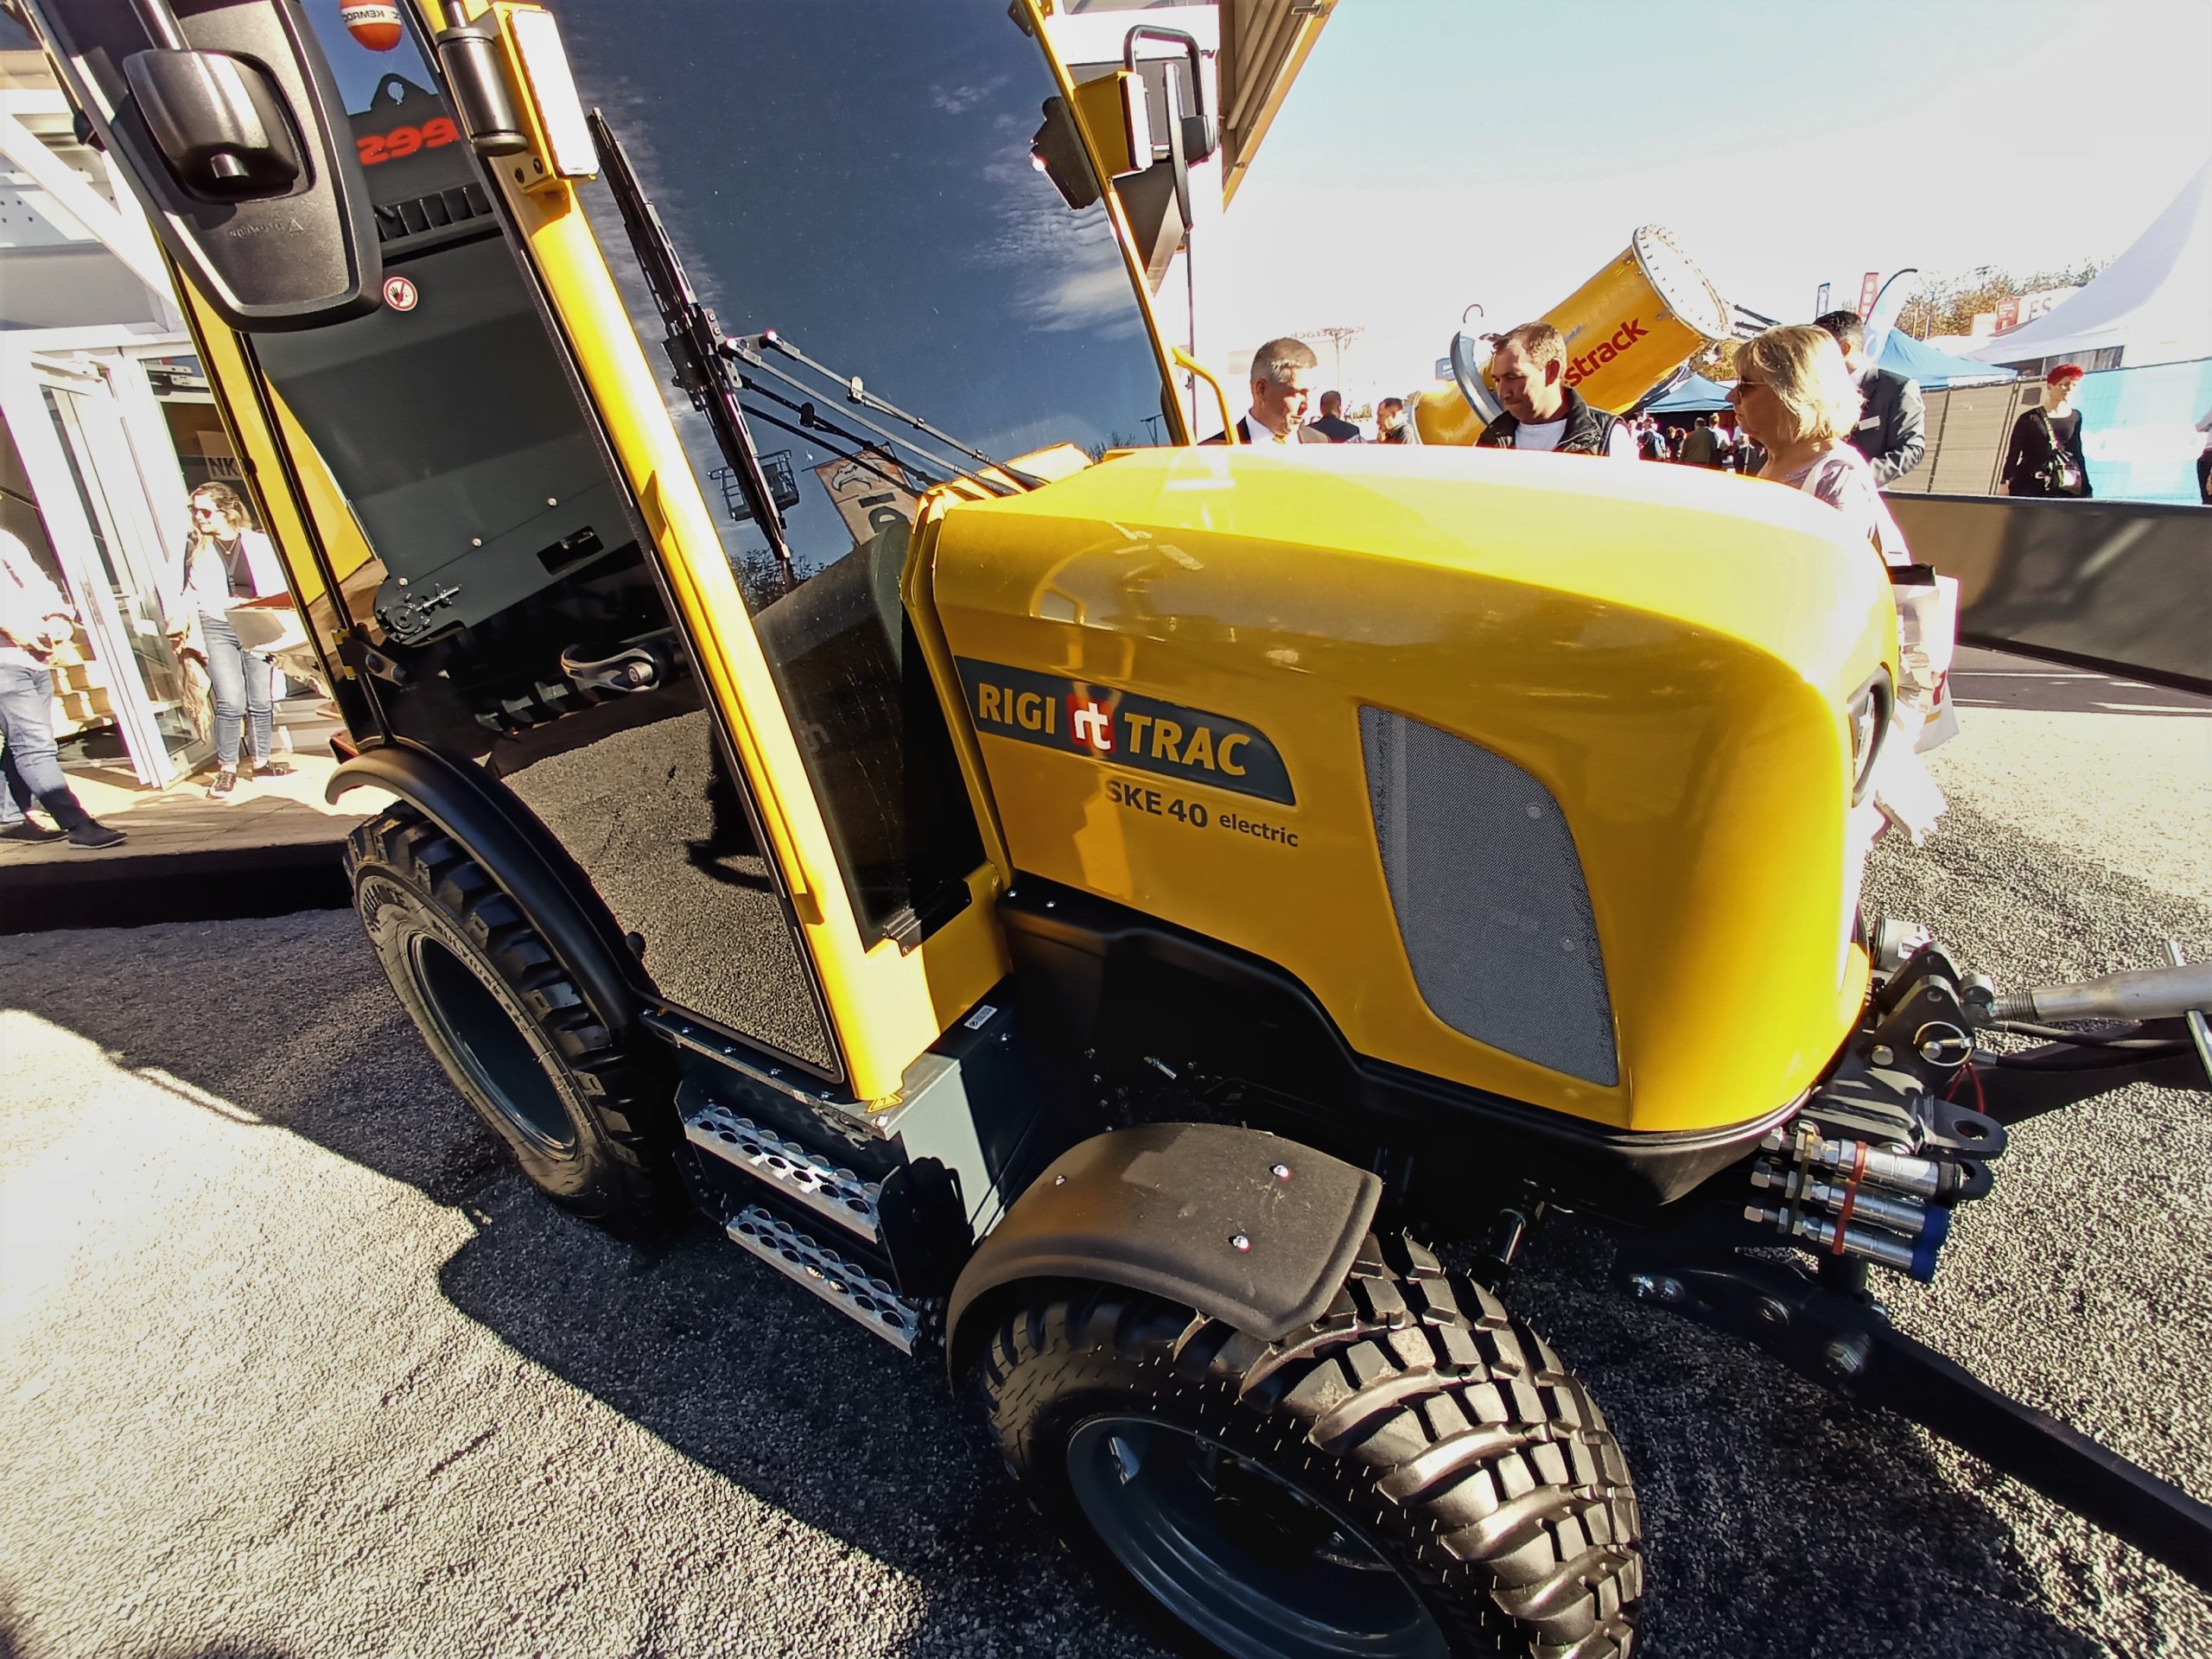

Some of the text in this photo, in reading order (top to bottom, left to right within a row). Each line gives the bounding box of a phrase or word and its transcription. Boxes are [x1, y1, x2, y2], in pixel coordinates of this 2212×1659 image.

[978, 683, 1056, 735] RIGI
[1124, 713, 1250, 776] TRAC
[1104, 780, 1300, 848] SKE 40 electric
